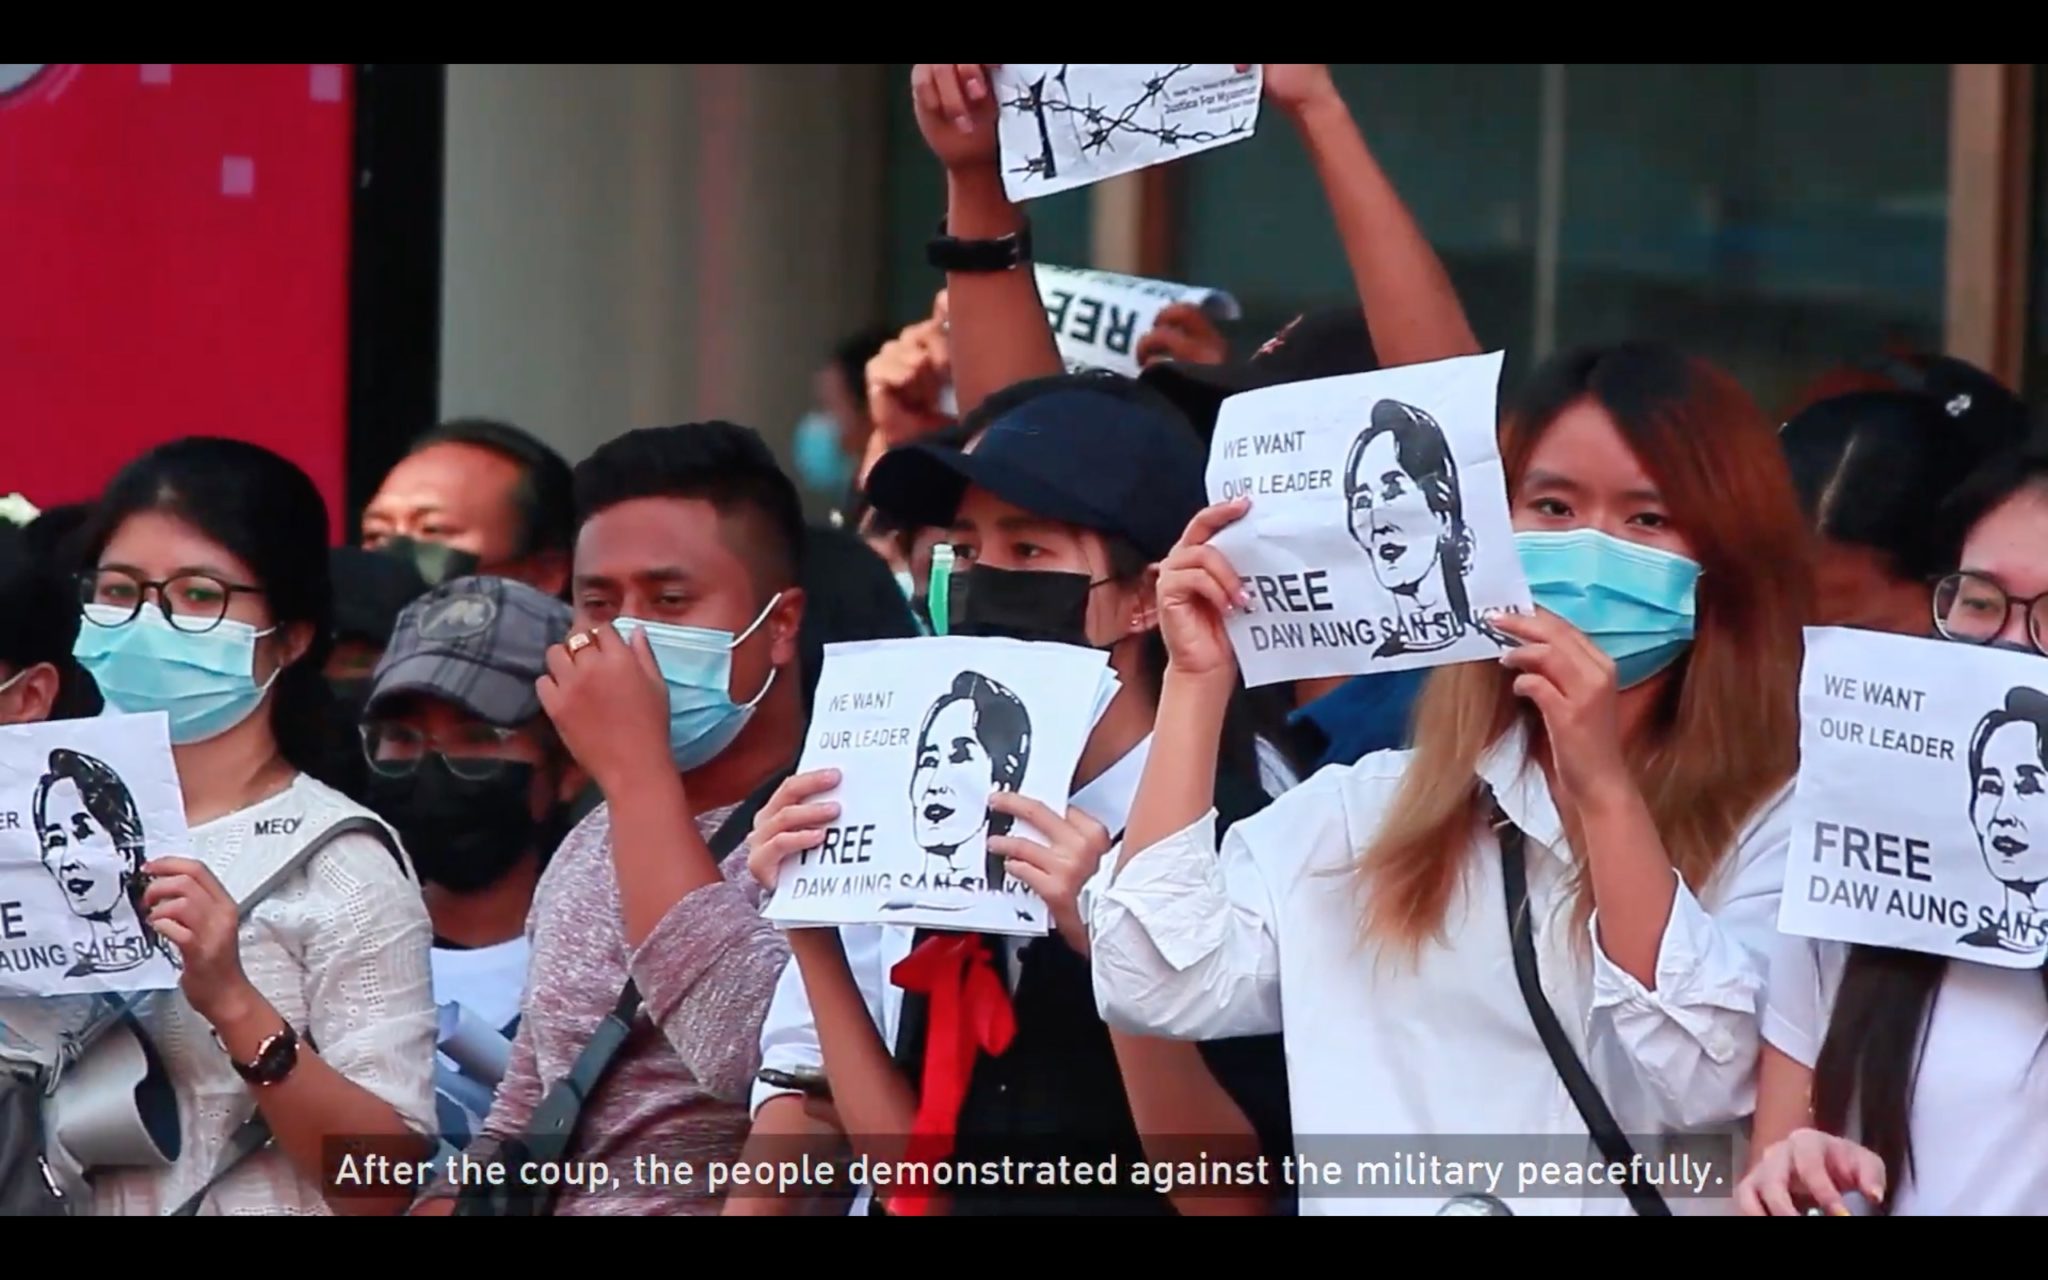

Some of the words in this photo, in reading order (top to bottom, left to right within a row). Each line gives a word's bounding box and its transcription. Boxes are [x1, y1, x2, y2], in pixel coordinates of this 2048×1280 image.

[1048, 290, 1139, 355] REE
[1223, 437, 1247, 460] WE
[1252, 430, 1306, 456] WANT
[1223, 477, 1253, 501] OUR
[1259, 469, 1332, 495] LEADER
[1250, 622, 1305, 651] DAW
[1309, 615, 1376, 649] AUNG
[1380, 612, 1429, 642] SAN
[853, 690, 894, 711] WANT
[1824, 674, 1857, 700] WE
[1862, 682, 1926, 713] WANT
[819, 730, 852, 750] OUR
[855, 727, 911, 748] LEADER
[1819, 717, 1864, 744] OUR
[1869, 727, 1955, 762] LEADER
[1812, 821, 1933, 883] FREE
[792, 877, 840, 900] DAW
[1808, 875, 1879, 912] DAW
[1885, 889, 1968, 929] AUNG
[1978, 904, 2032, 943] SAN
[73, 936, 117, 963] SAN
